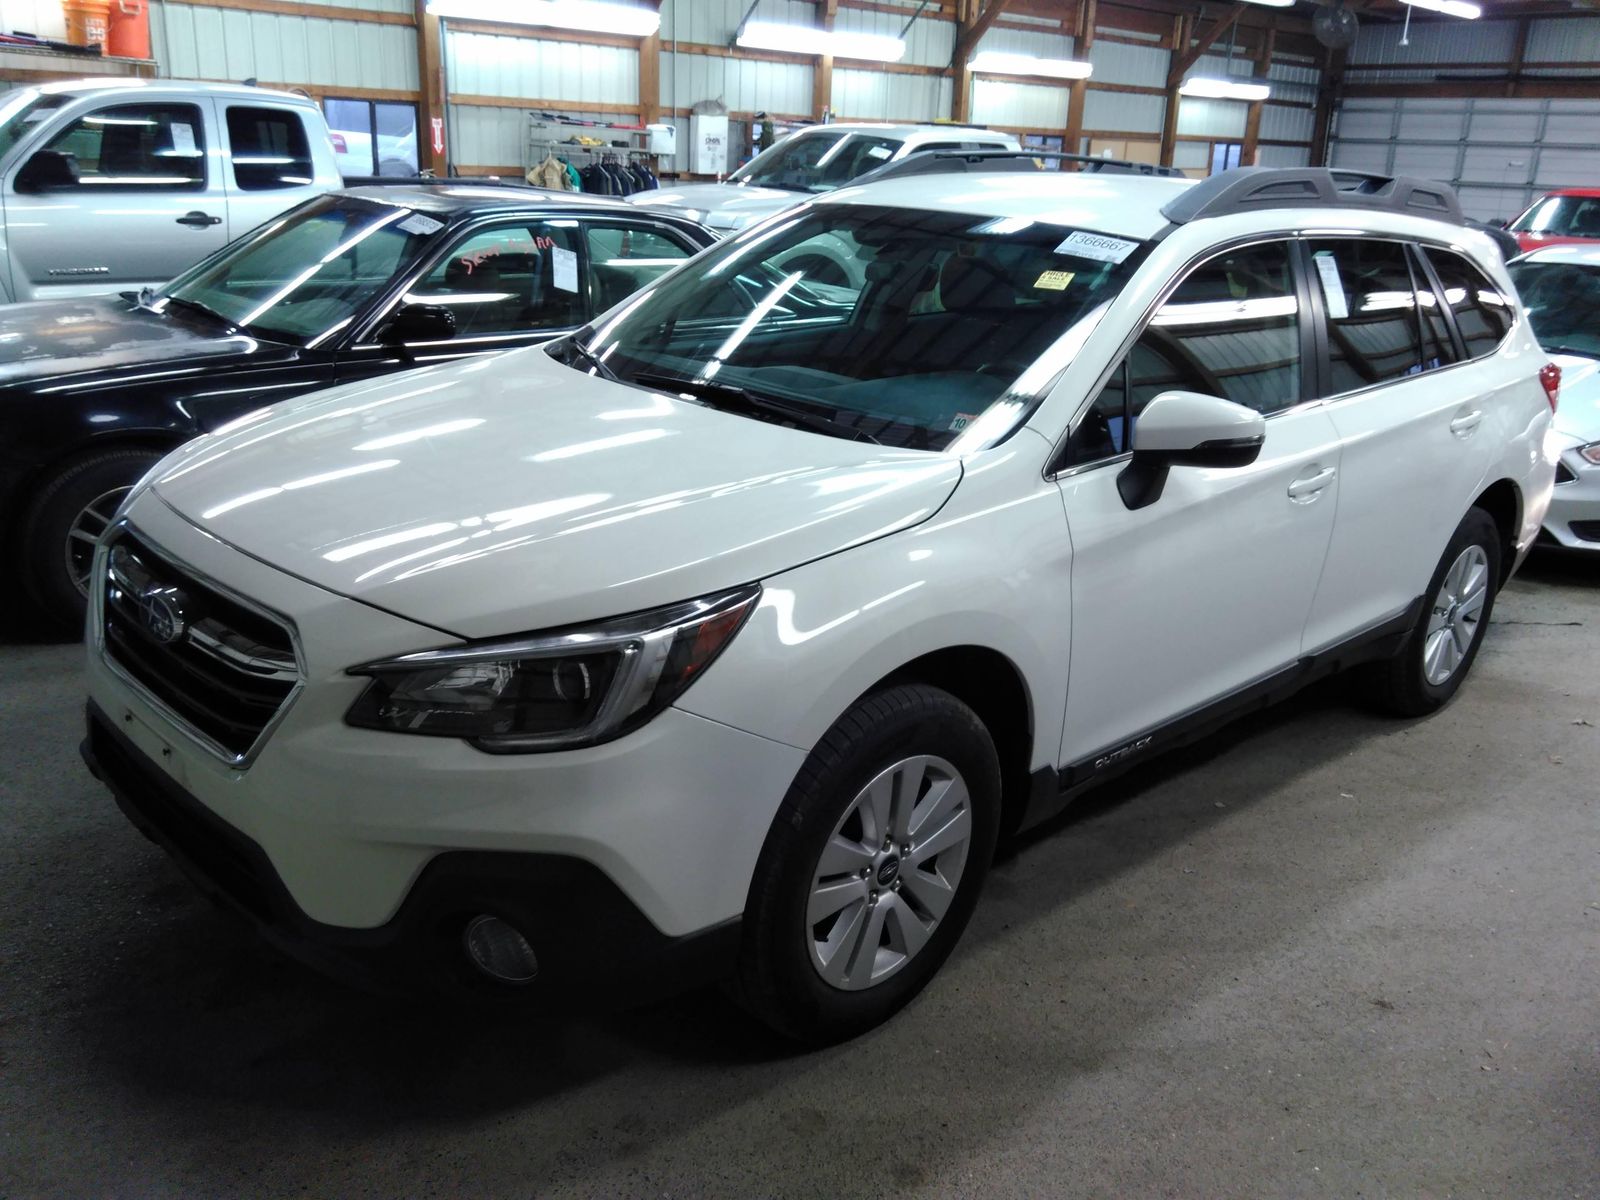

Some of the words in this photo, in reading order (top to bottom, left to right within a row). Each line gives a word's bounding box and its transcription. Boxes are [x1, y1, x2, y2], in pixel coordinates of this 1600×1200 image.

[1070, 234, 1130, 251] 1366667
[955, 418, 967, 429] 10
[1095, 736, 1153, 769] OUTBACK
